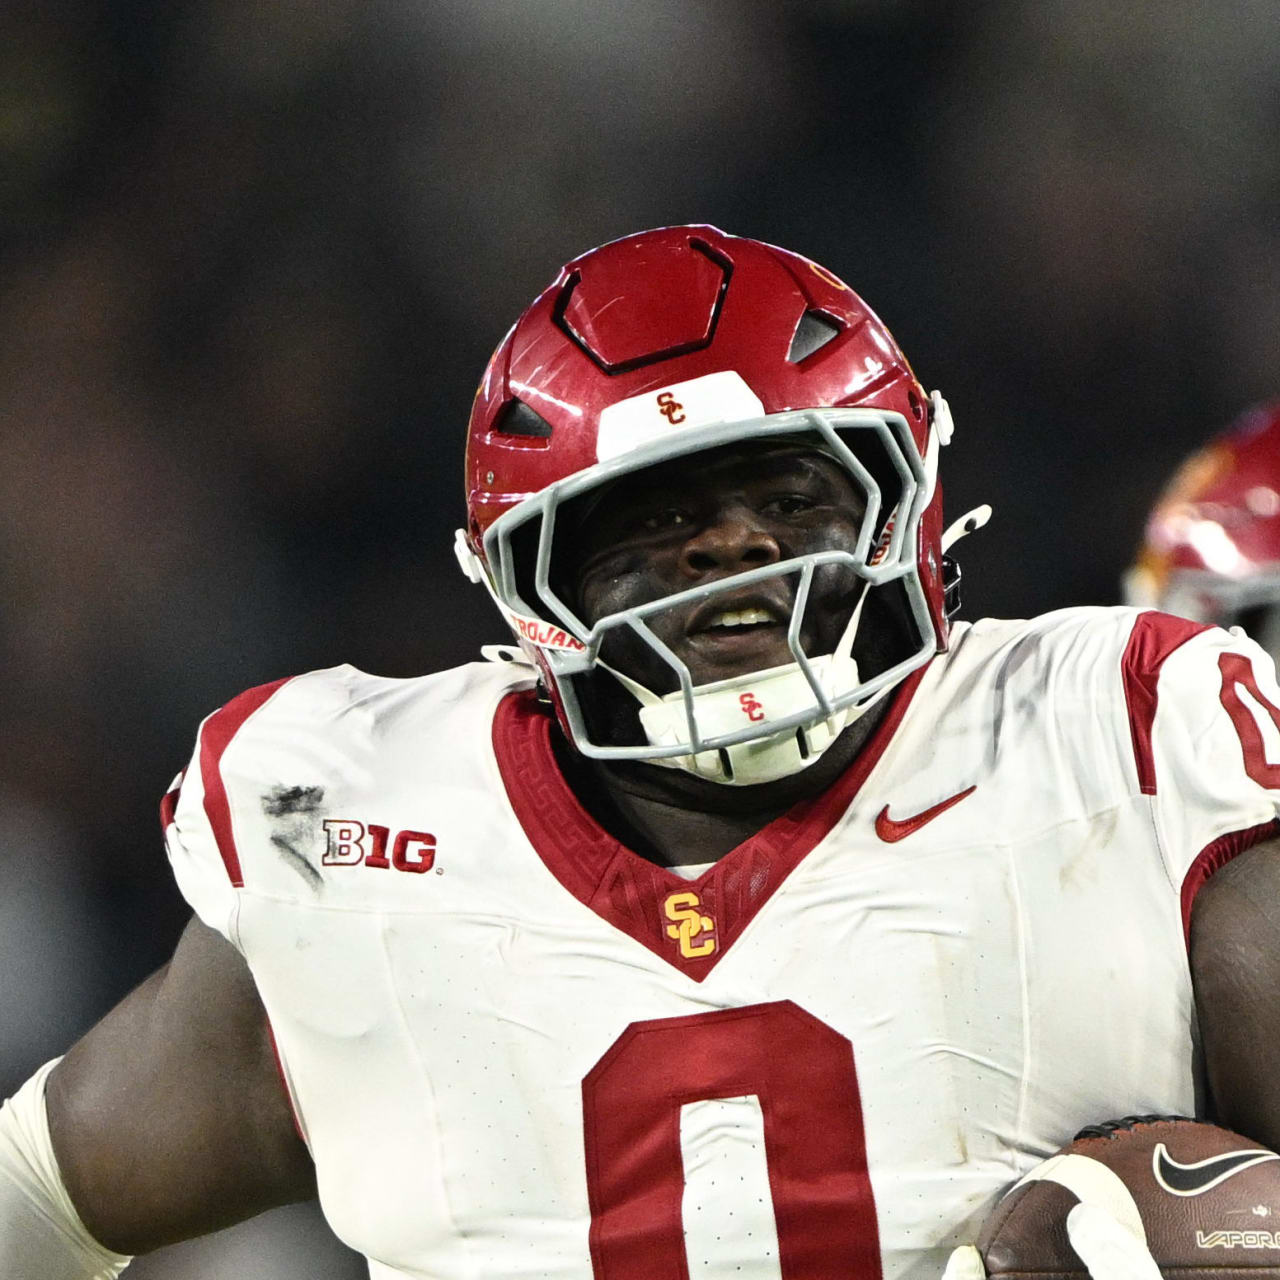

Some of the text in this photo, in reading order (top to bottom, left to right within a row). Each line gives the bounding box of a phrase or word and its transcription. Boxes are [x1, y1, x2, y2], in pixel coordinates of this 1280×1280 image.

[656, 391, 686, 425] SC
[739, 693, 765, 721] SC
[664, 892, 715, 958] SC
